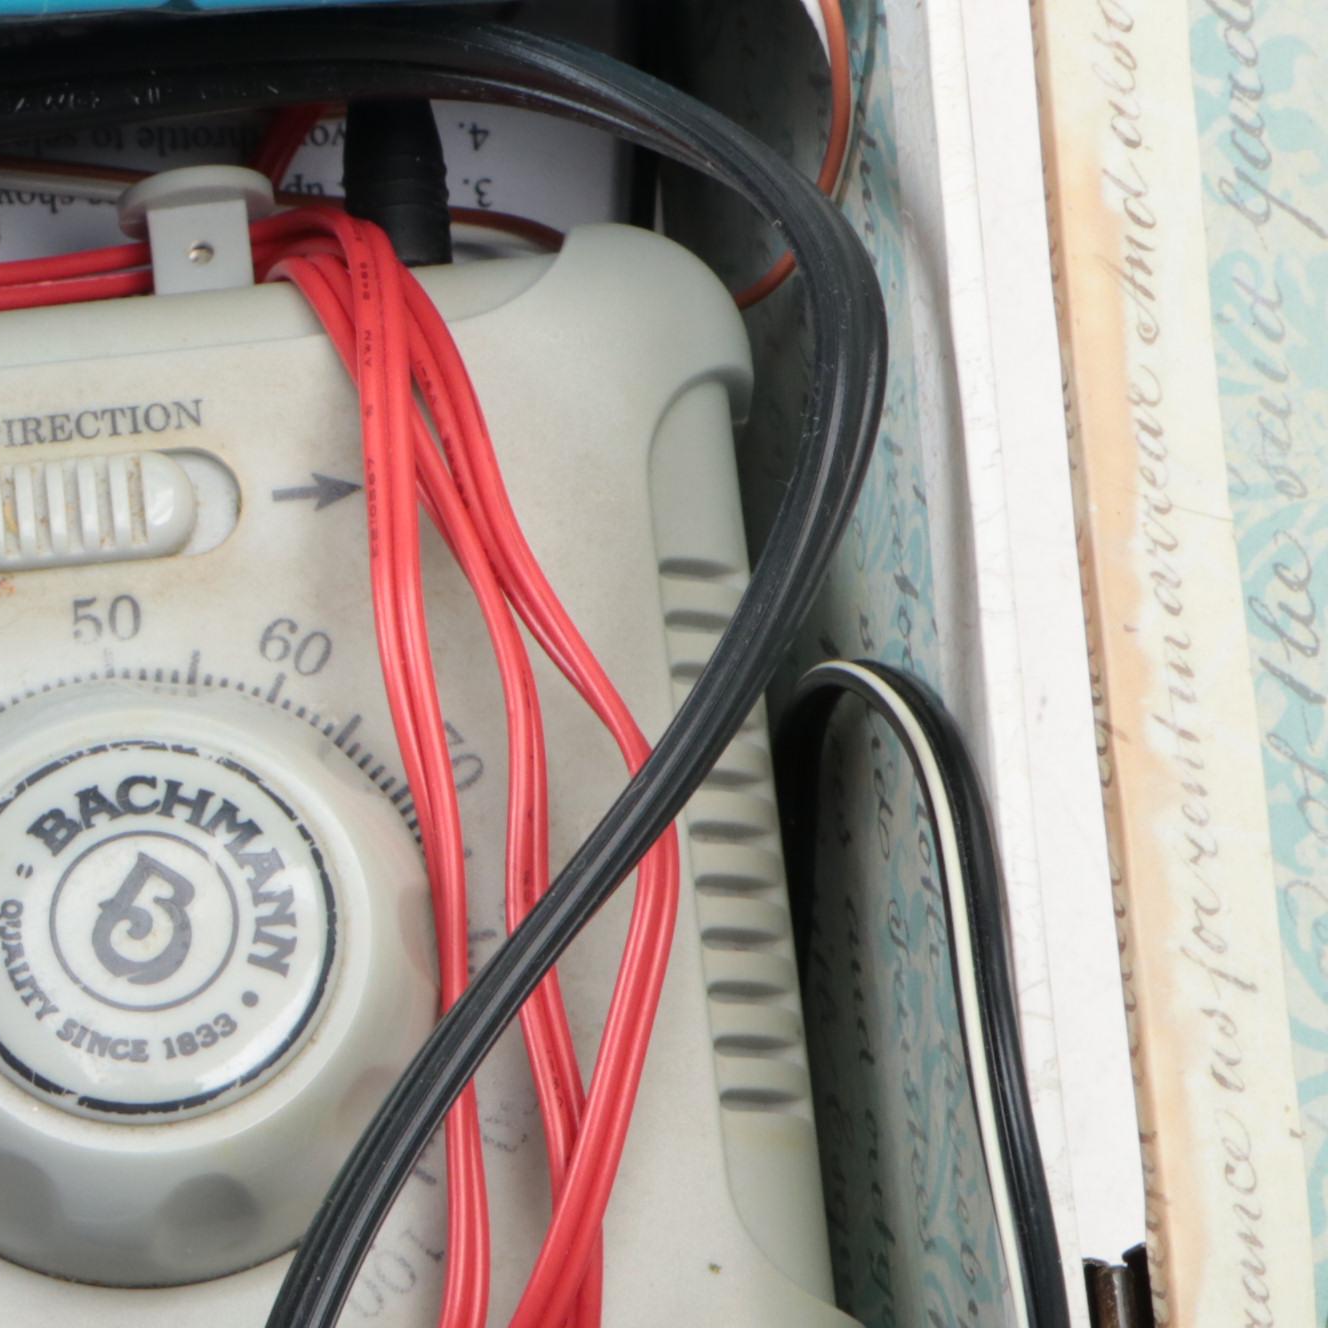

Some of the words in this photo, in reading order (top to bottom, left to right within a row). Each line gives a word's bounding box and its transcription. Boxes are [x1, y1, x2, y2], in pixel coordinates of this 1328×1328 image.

[92, 127, 125, 152] to
[458, 121, 491, 150] 4.
[463, 176, 493, 209] 3.
[72, 594, 142, 642] 50
[258, 617, 333, 676] 60
[26, 775, 298, 978] BACHMANN
[56, 1017, 150, 1063] SINCE
[162, 1012, 239, 1061] 1833
